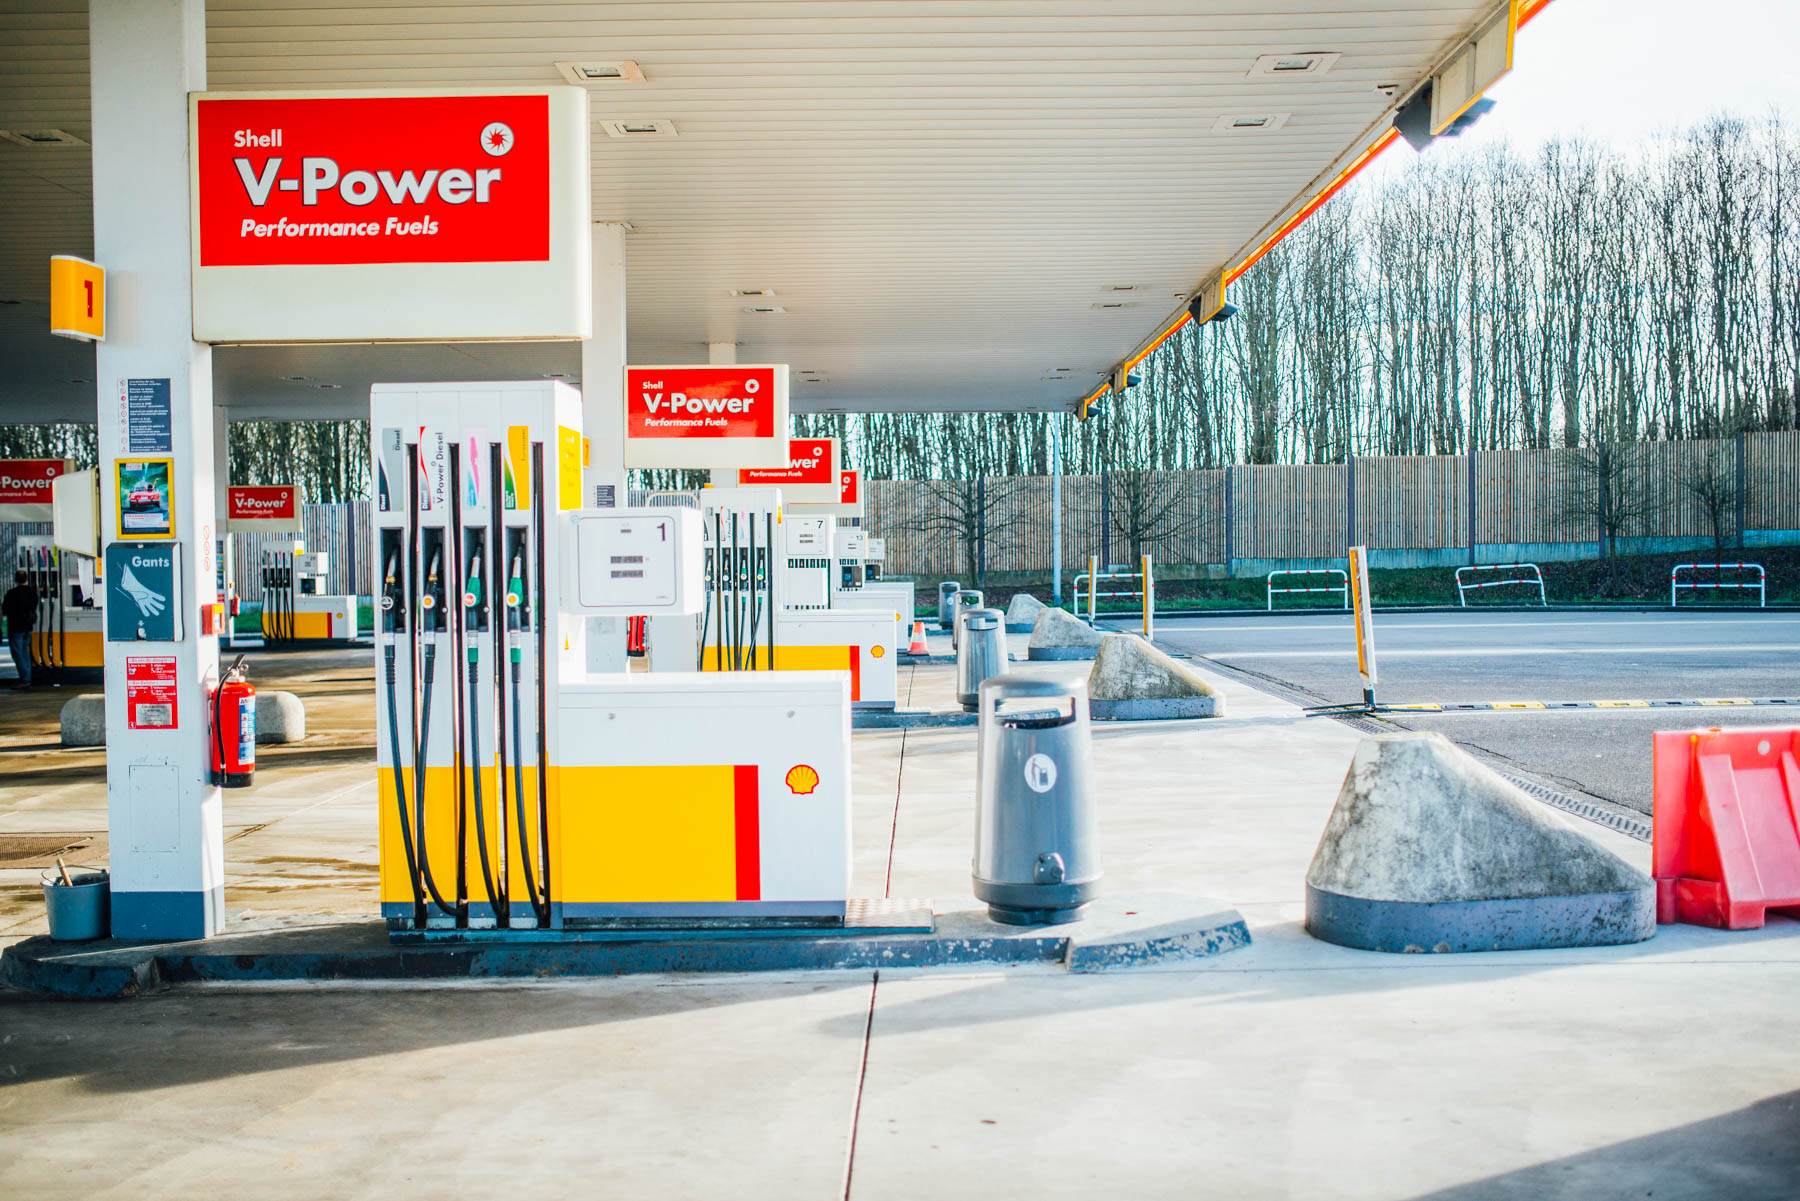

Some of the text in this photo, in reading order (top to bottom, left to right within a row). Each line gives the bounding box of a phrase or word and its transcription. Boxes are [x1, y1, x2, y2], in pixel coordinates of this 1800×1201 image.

[233, 128, 283, 148] Shell
[233, 156, 502, 207] V-Power
[240, 214, 440, 238] Performance Fuels
[83, 279, 94, 319] 1
[642, 381, 664, 390] Shell
[642, 392, 755, 414] V-Power
[644, 417, 729, 428] Performance Fuels
[0, 475, 52, 489] Power
[436, 464, 444, 503] V-Power
[235, 497, 286, 508] V-Power
[656, 522, 666, 542] 1
[817, 520, 824, 529] 7
[131, 555, 170, 568] Gants
